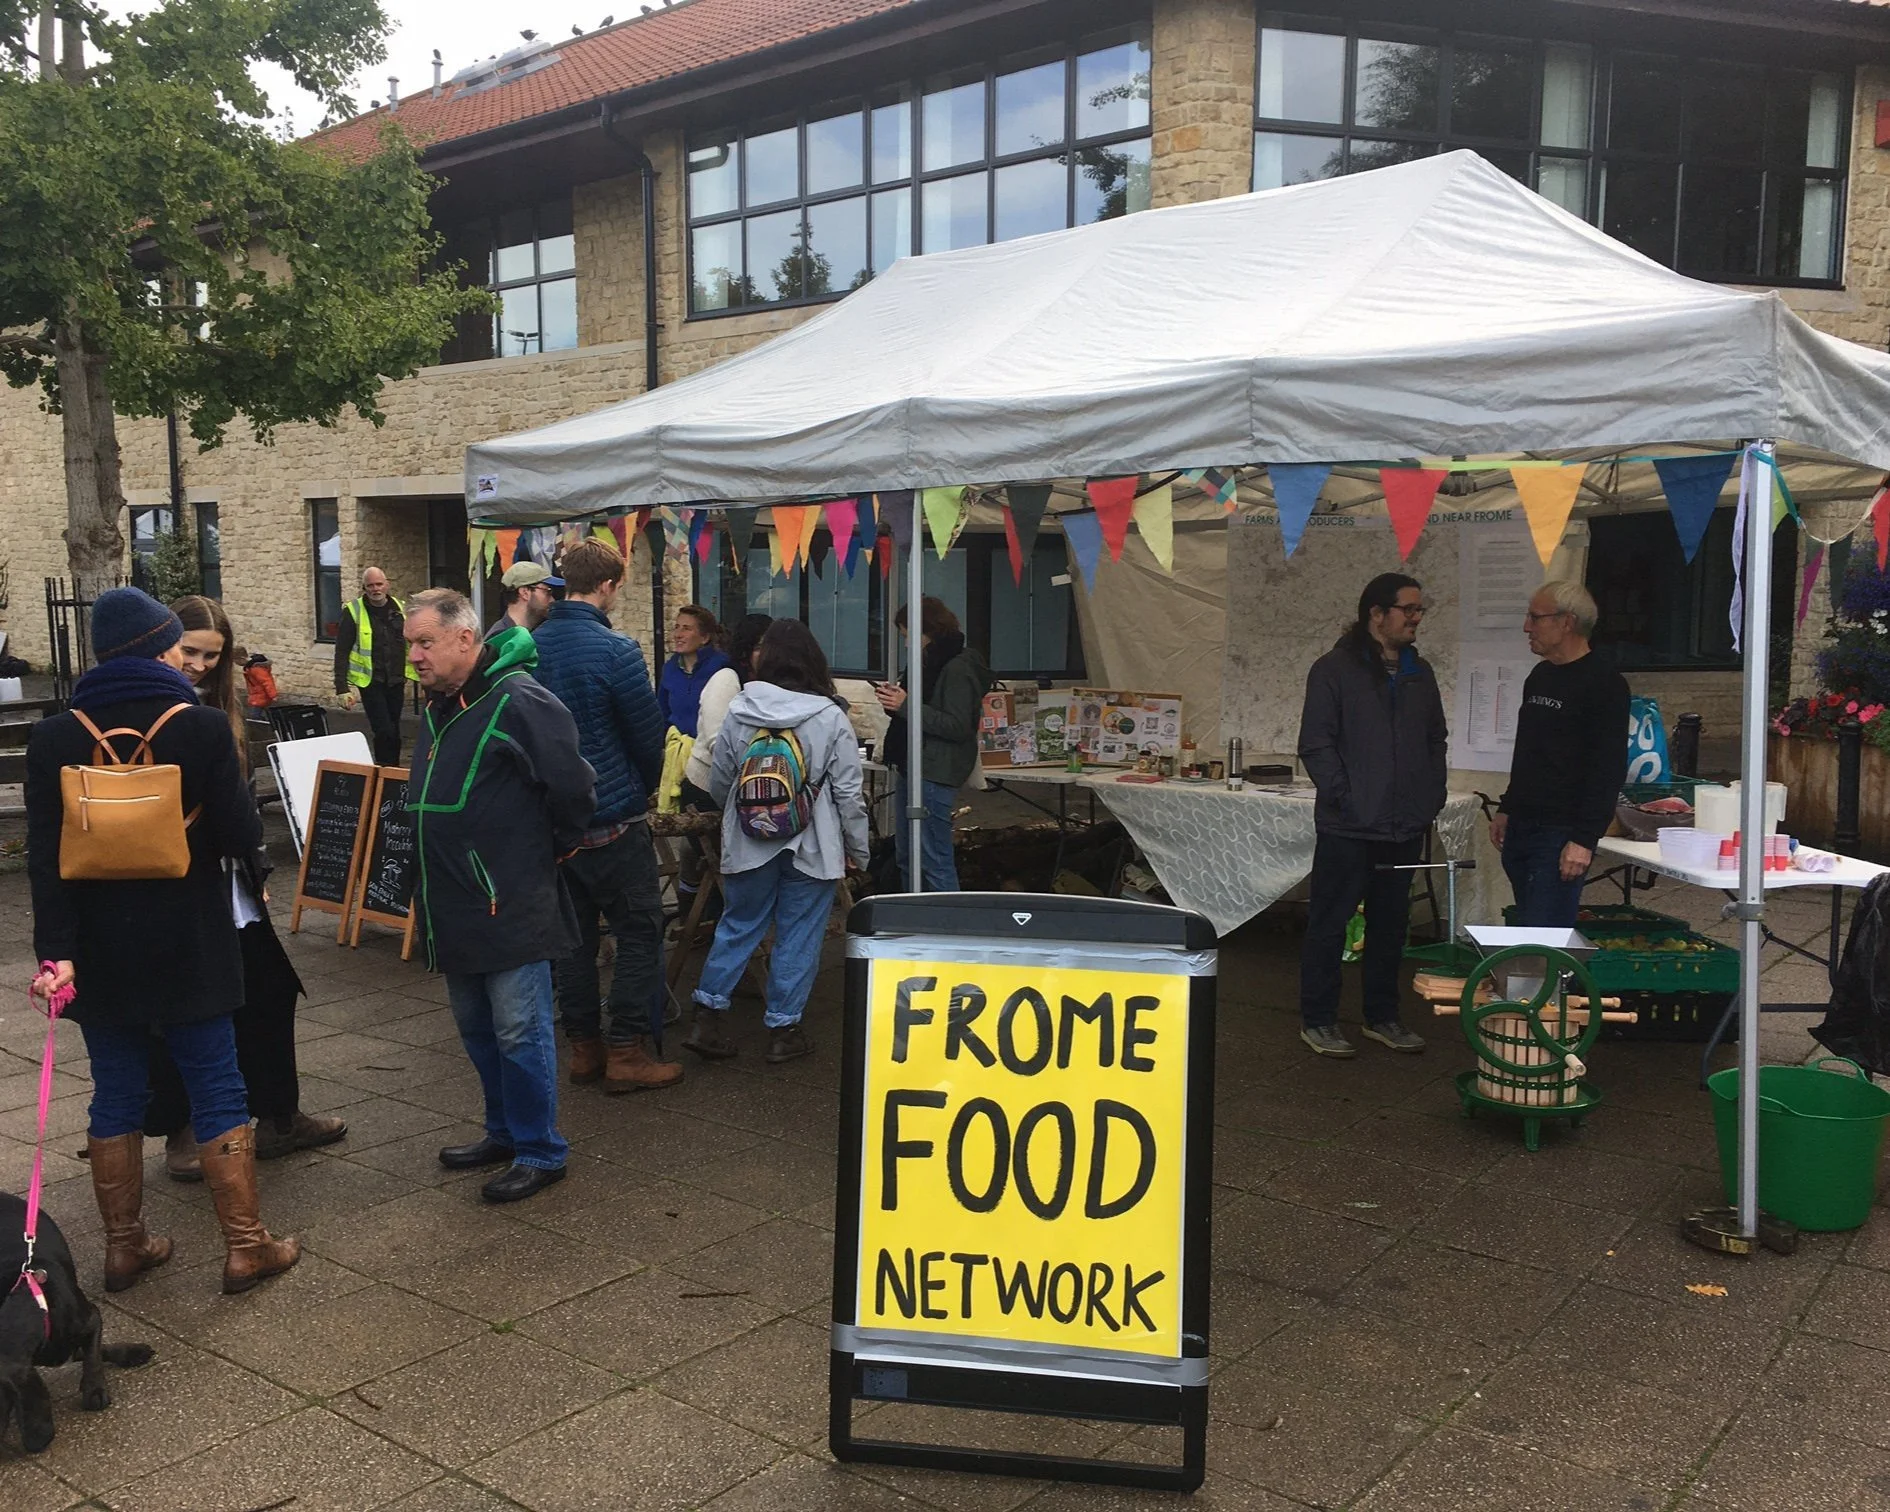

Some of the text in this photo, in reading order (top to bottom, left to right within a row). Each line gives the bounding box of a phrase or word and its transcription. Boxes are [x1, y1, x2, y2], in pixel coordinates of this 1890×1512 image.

[1245, 515, 1274, 525] FARMS
[1442, 512, 1471, 523] NEAR
[1474, 510, 1513, 521] FROME
[890, 976, 1161, 1076] FROME
[882, 1089, 1158, 1221] FOOD
[874, 1247, 1166, 1333] NETWORK
